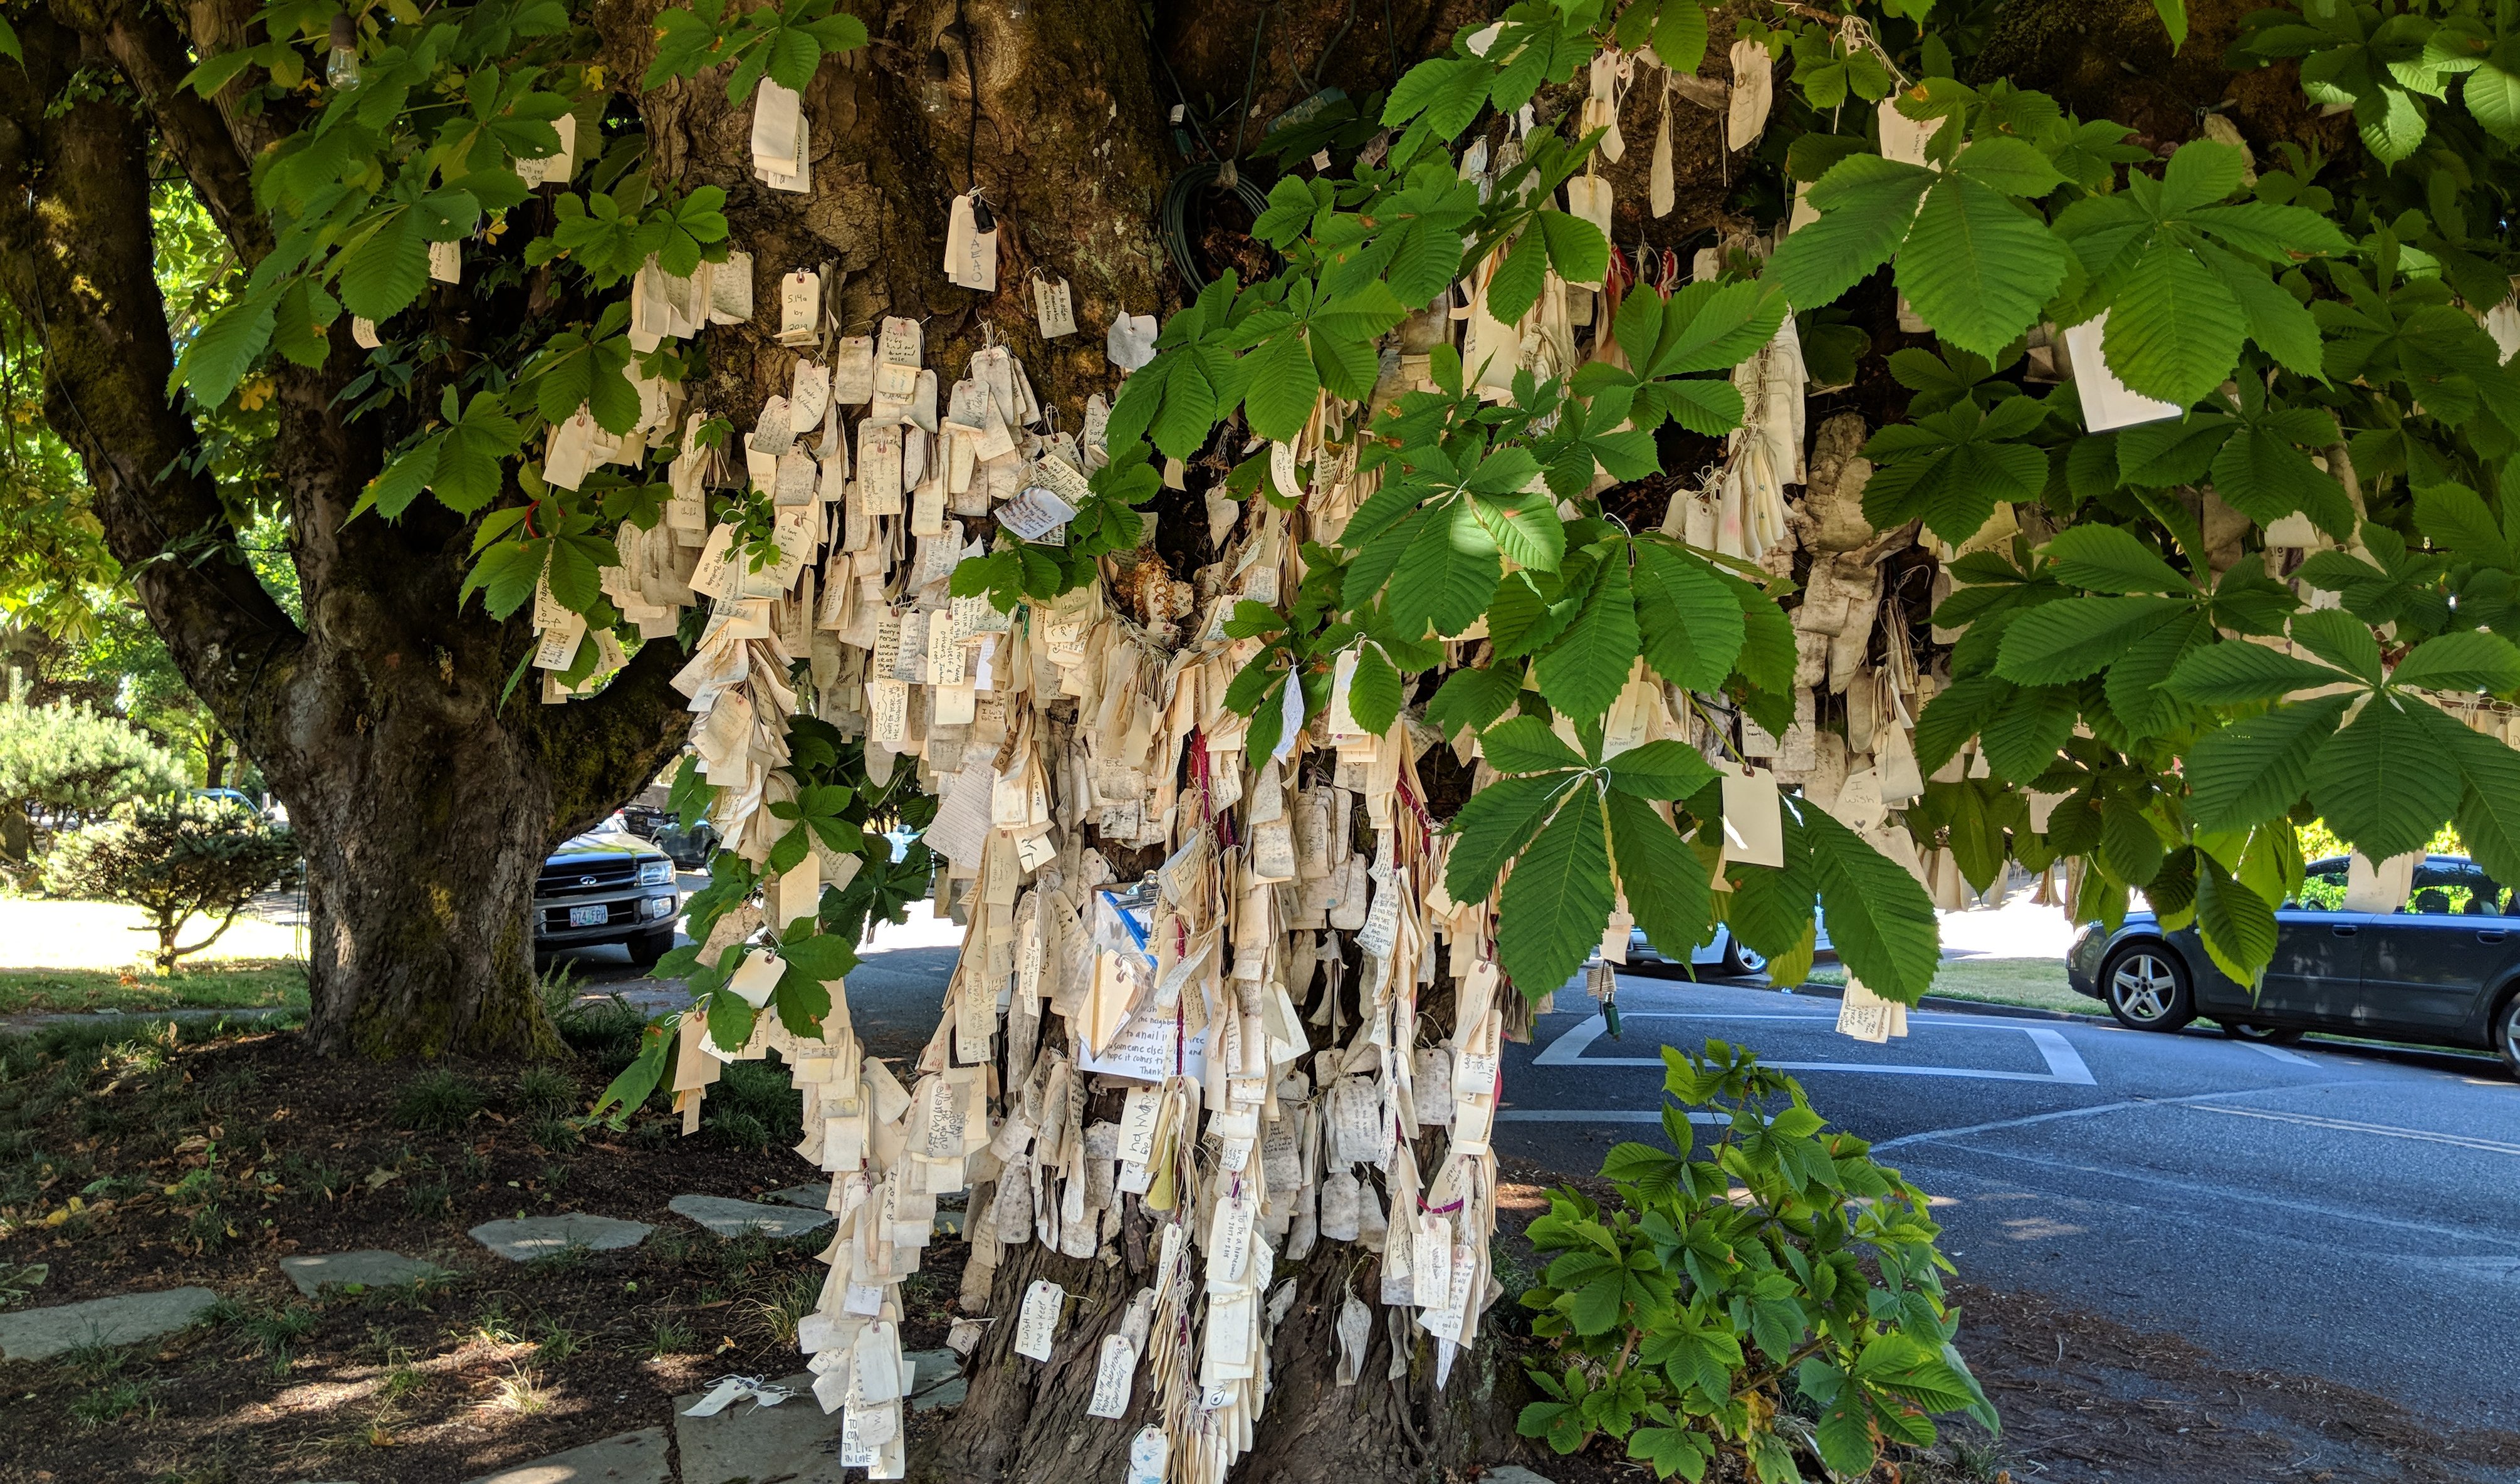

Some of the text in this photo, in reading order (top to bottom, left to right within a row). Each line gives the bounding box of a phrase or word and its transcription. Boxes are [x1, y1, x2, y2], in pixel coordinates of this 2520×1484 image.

[538, 608, 551, 625] for
[1851, 781, 1863, 791] I
[1844, 795, 1874, 803] wish
[591, 909, 607, 921] FPH
[1150, 1017, 1176, 1028] neighbo
[1486, 1032, 1495, 1060] wish
[1107, 1051, 1122, 1061] hope
[848, 1419, 857, 1429] TO
[843, 1442, 851, 1451] TO
[855, 1454, 871, 1463] LOVE
